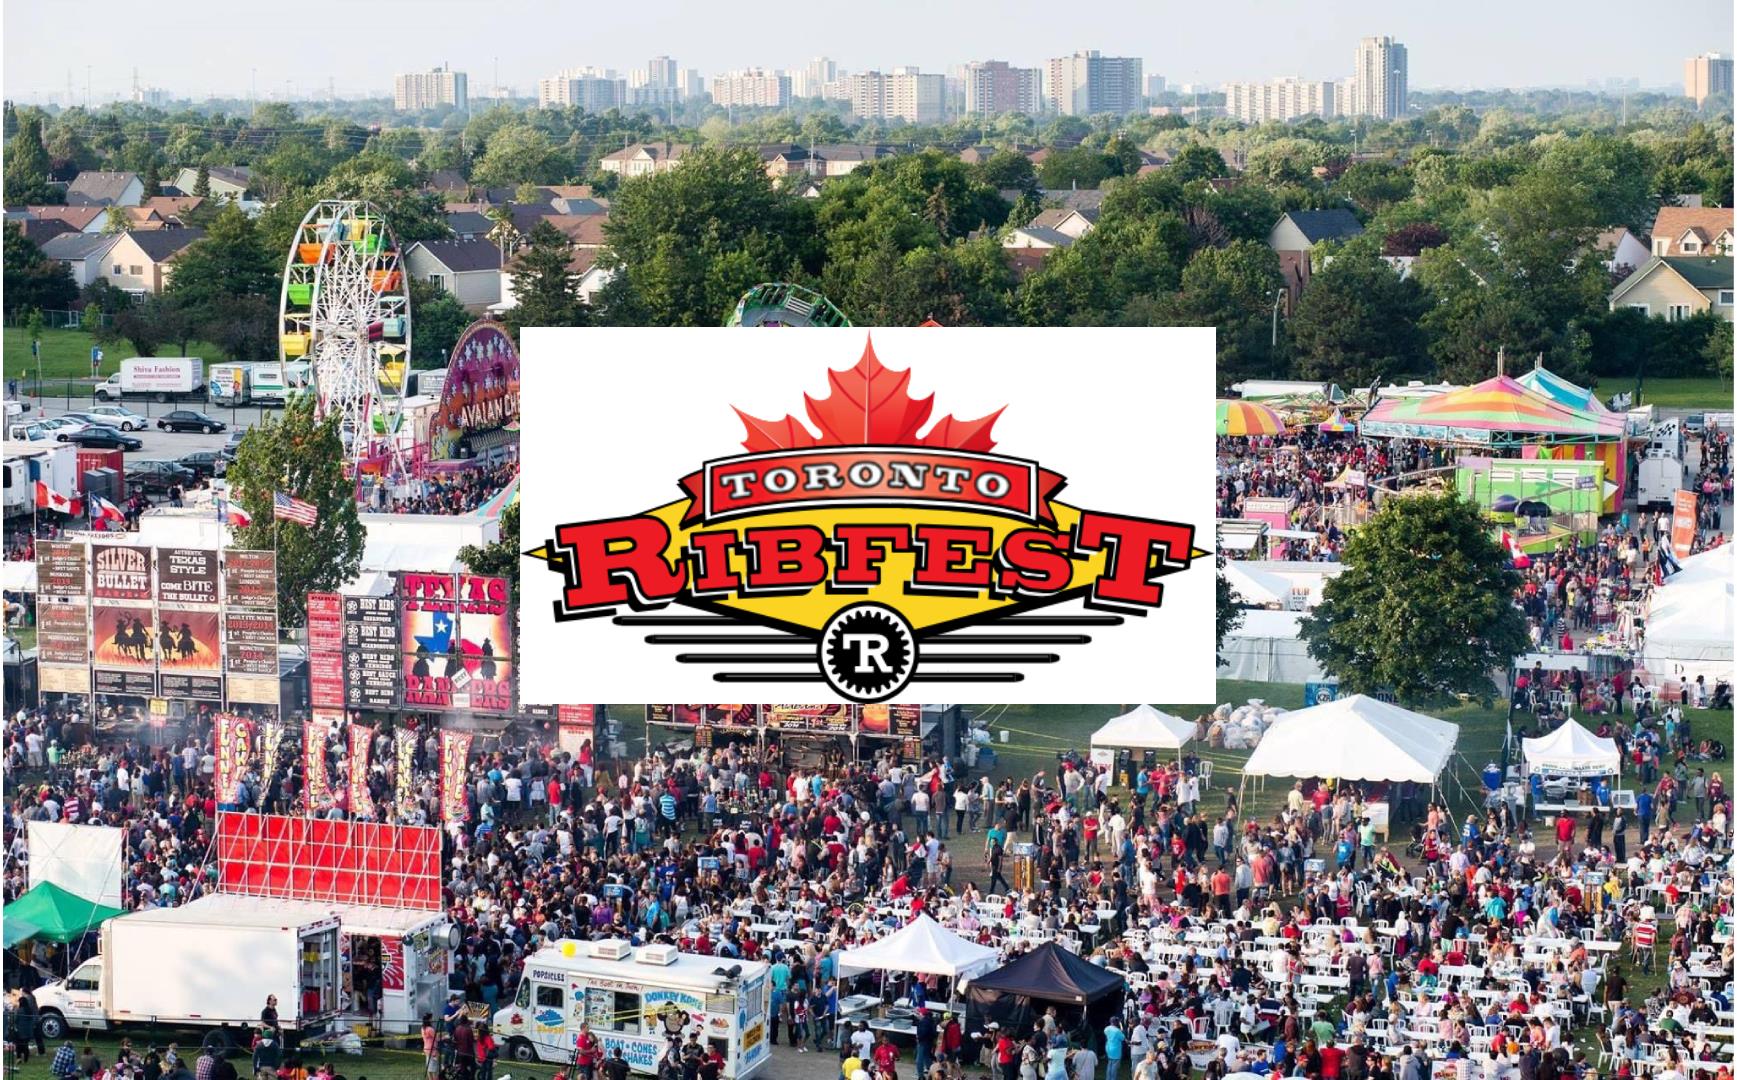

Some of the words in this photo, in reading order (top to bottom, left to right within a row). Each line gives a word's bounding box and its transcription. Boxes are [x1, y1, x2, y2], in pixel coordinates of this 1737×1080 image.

[133, 365, 152, 373] Shiva
[154, 365, 181, 373] Fashion
[96, 547, 146, 571] SILVER
[169, 555, 206, 565] TEXAS
[169, 565, 207, 574] STYLE
[97, 574, 148, 590] BULLET
[161, 582, 182, 590] COME
[183, 580, 213, 592] BITE
[162, 592, 179, 600] THE
[180, 593, 209, 602] BULLET
[404, 575, 507, 615] TEXAS
[404, 676, 511, 711] RANERS
[533, 969, 565, 982] POPSICLES
[645, 991, 680, 1003] DONKEY
[604, 1038, 626, 1050] BOAT
[631, 1042, 659, 1057] CONES
[622, 1051, 654, 1067] SHAKES
